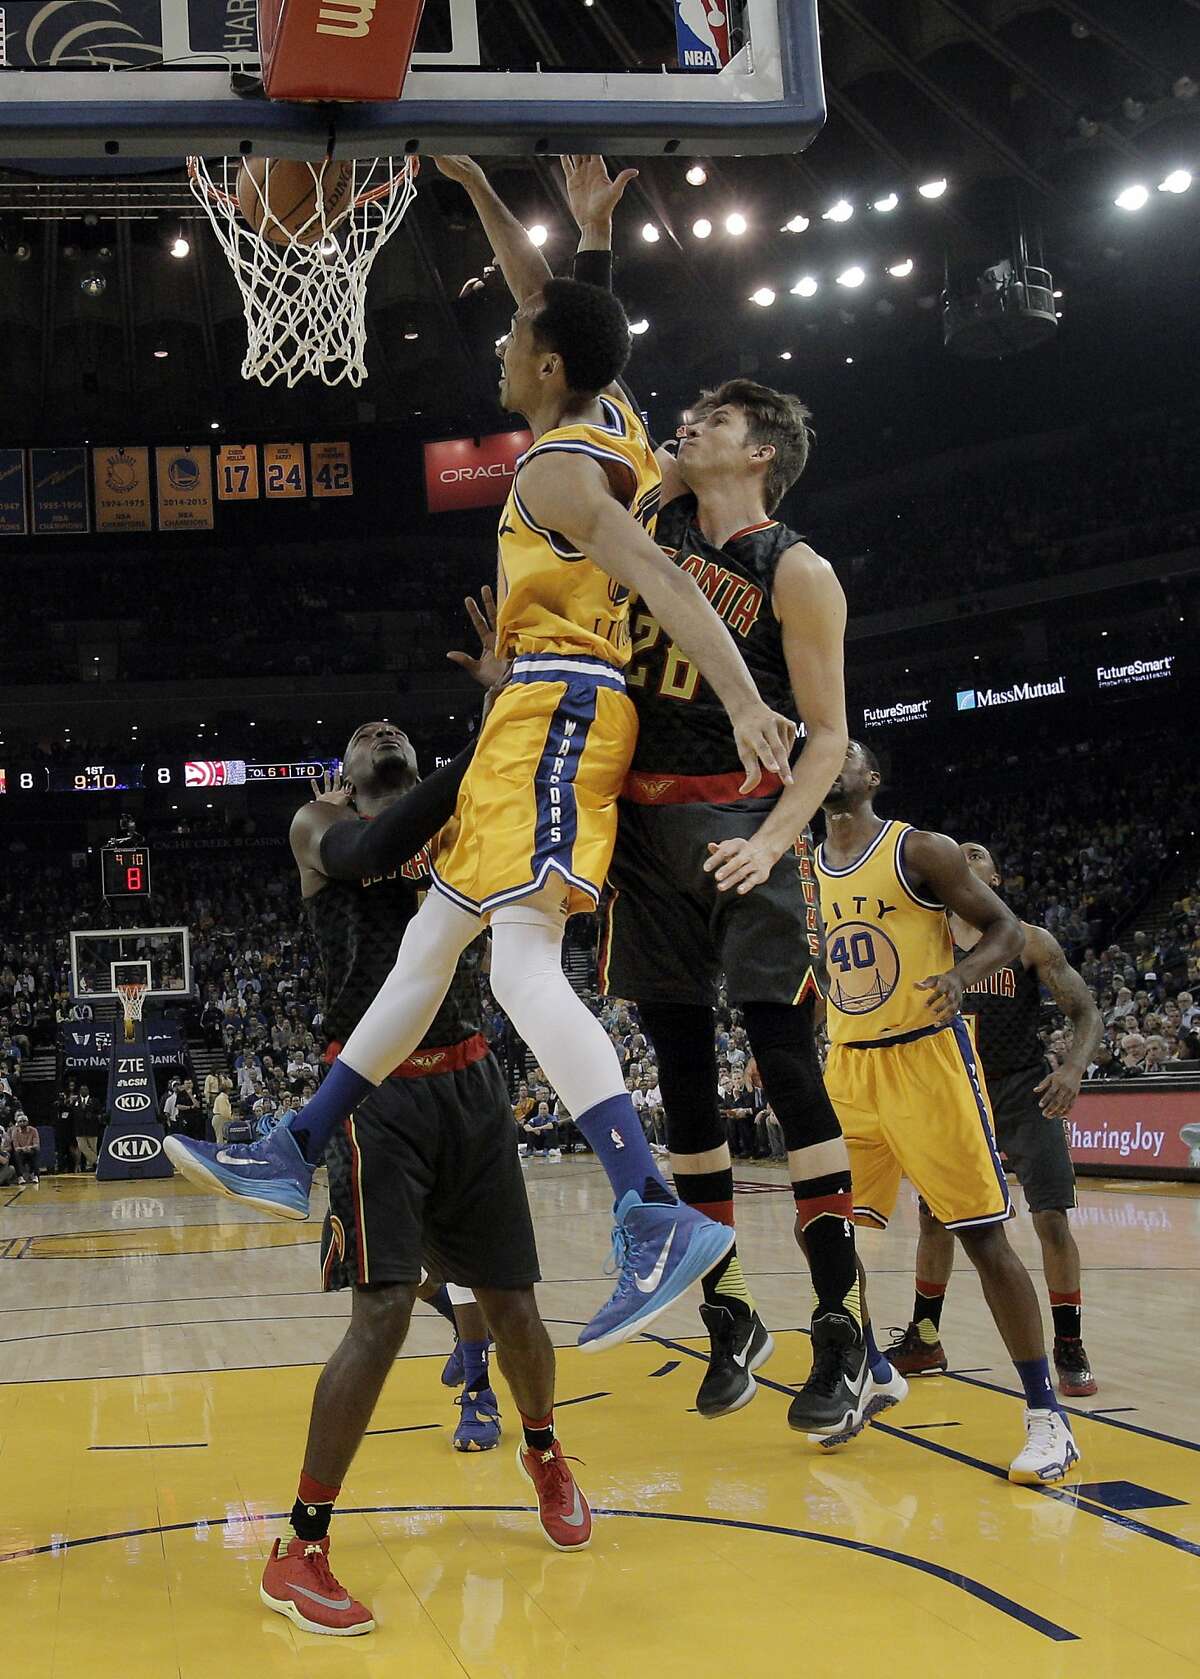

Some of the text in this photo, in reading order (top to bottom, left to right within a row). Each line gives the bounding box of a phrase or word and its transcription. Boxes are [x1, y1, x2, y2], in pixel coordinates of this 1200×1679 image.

[684, 50, 714, 66] NBA
[224, 466, 250, 493] 17
[268, 464, 302, 491] 24
[316, 463, 350, 489] 42
[440, 463, 516, 483] ORACL
[1096, 657, 1172, 681] FutureSmart
[976, 676, 1066, 707] MassMutual
[863, 701, 930, 722] FutureSmart
[20, 772, 34, 789] 8
[85, 766, 105, 775] 1ST
[157, 767, 171, 784] 8
[74, 774, 117, 789] 9:10
[127, 868, 141, 890] 8
[830, 896, 897, 921] ITY
[830, 931, 876, 973] 40
[117, 1058, 145, 1073] ZTE
[128, 1078, 148, 1087] CSN
[121, 1096, 145, 1108] KIA
[117, 1140, 153, 1156] KIA
[1069, 1121, 1166, 1157] haringJoy
